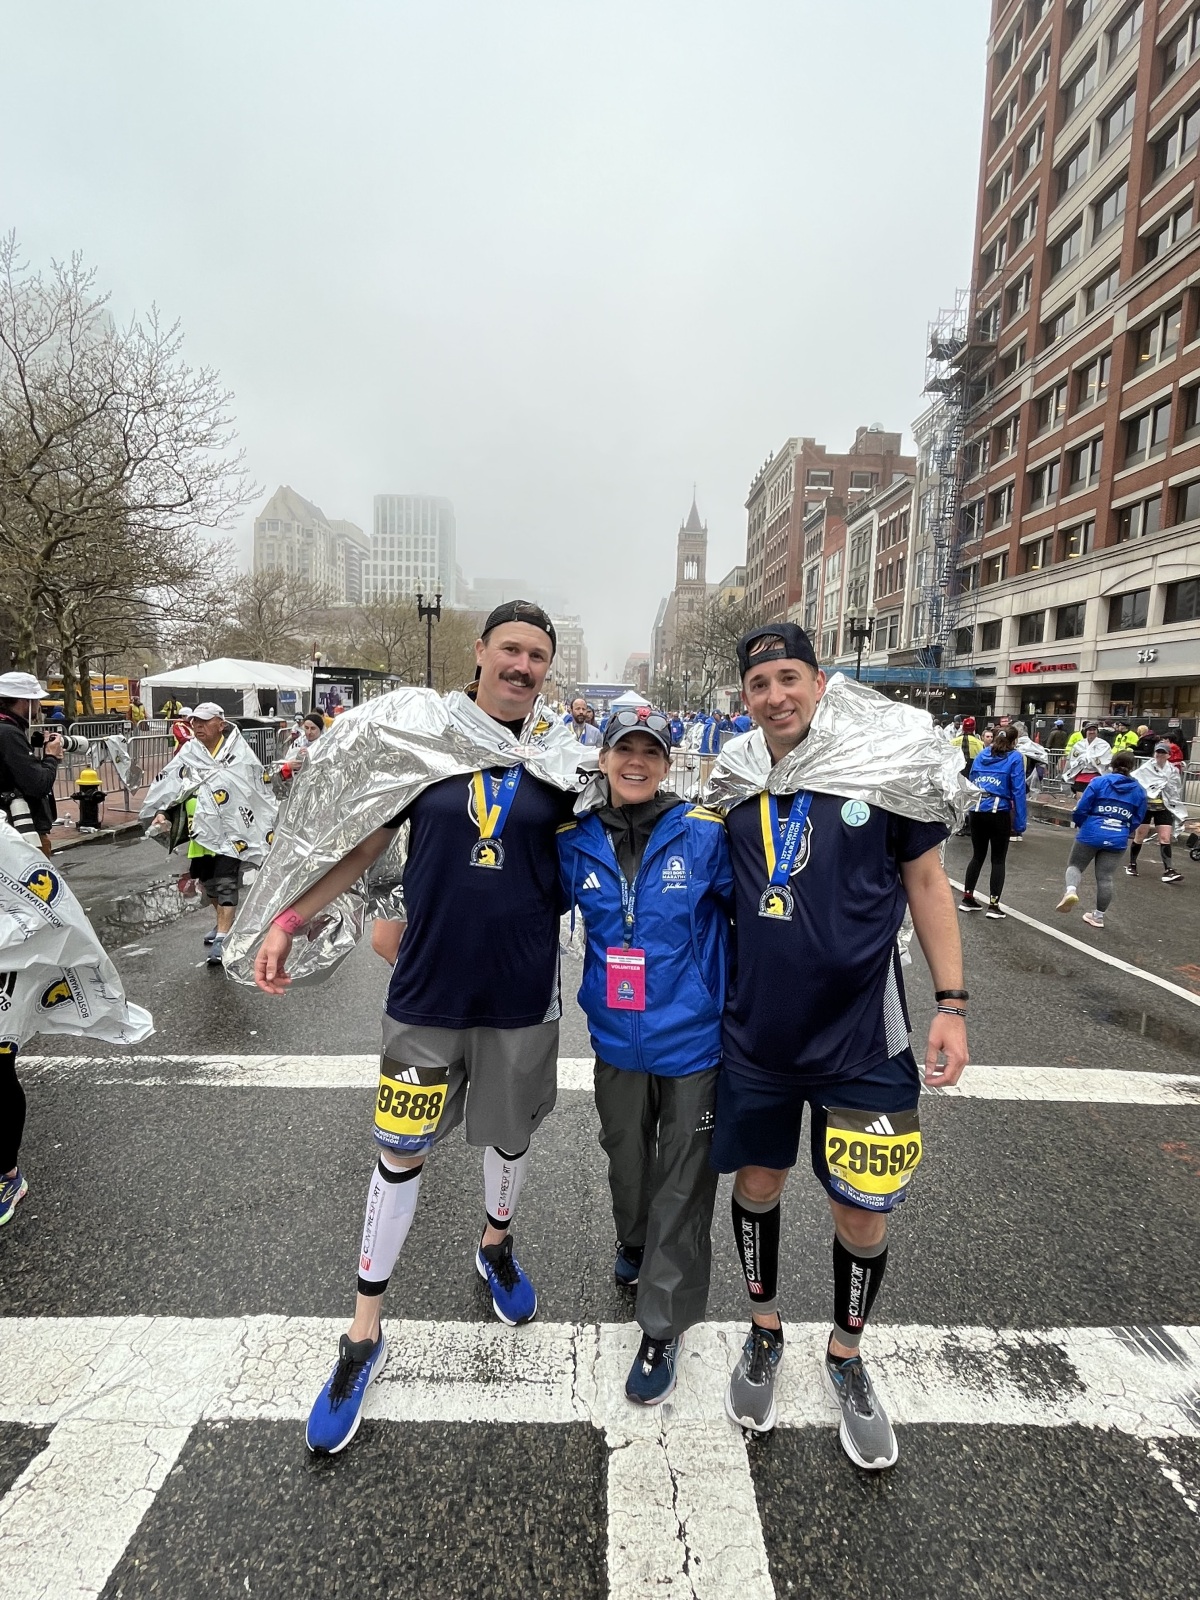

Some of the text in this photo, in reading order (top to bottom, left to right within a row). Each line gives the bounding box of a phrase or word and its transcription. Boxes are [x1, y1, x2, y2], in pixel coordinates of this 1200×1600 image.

[1011, 661, 1041, 674] GNC
[1137, 649, 1156, 663] 545
[1098, 805, 1133, 819] BOSTON
[785, 821, 796, 847] BOSTON
[786, 822, 801, 860] MARATHON
[0, 871, 64, 929] OSTON MARATHON
[75, 990, 89, 1019] BOSTON
[378, 1084, 443, 1121] 9388
[828, 1137, 920, 1177] 29592
[847, 1191, 885, 1207] MARATHON
[860, 1193, 885, 1202] BOSTON
[742, 1217, 755, 1281] COMPRESPORT
[848, 1263, 864, 1316] COMPRESPORT
